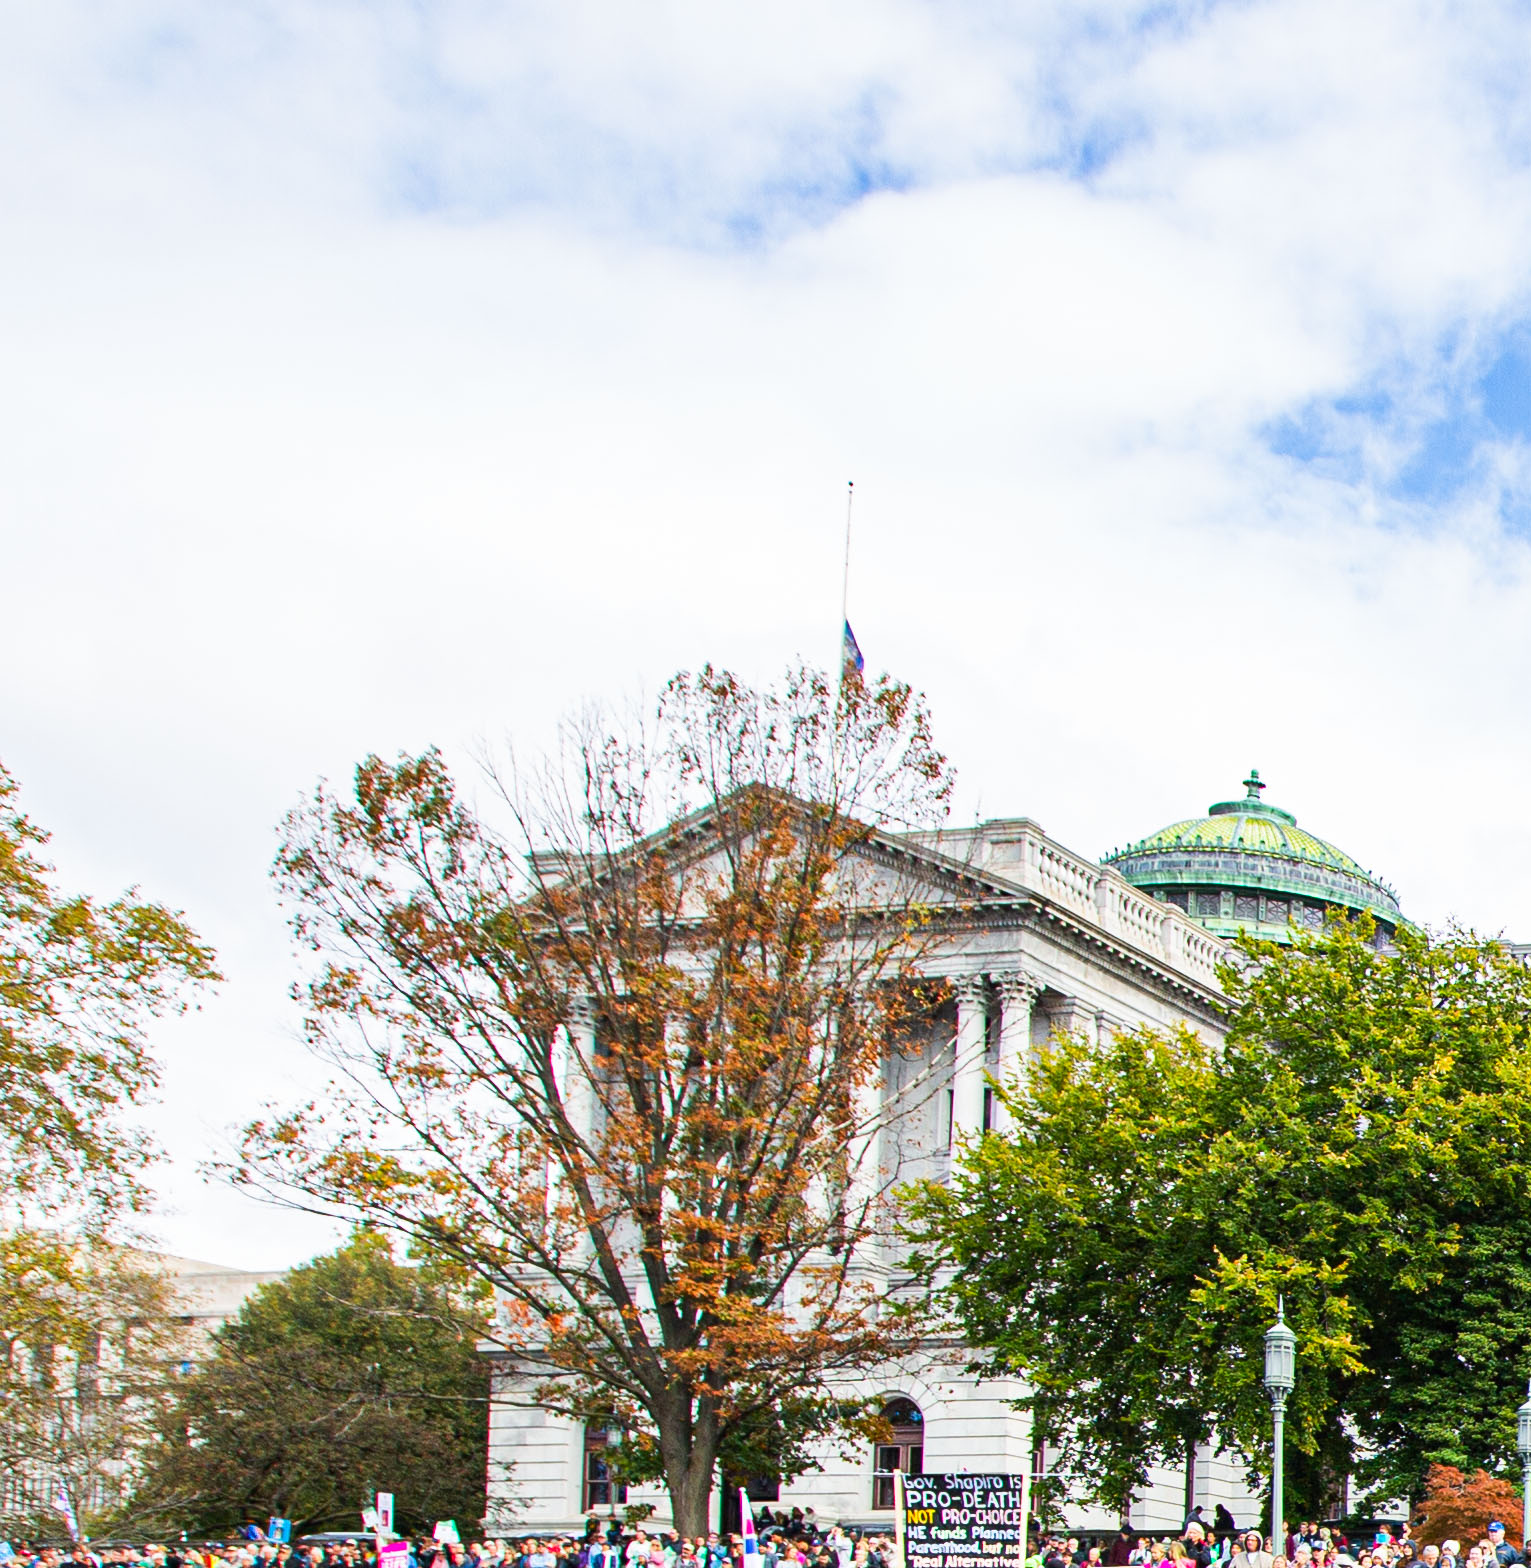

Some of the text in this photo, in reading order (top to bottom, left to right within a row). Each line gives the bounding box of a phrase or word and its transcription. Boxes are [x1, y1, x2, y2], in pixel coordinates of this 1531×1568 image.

[903, 1474, 937, 1489] Gov.
[945, 1474, 1003, 1493] Shapiro
[906, 1491, 1021, 1508] PRO-DEATH
[907, 1509, 1021, 1525] NOT PRO-CHOICE
[908, 1526, 927, 1539] HE
[930, 1526, 967, 1540] funds
[908, 1541, 981, 1555] Parenthood,
[982, 1541, 1003, 1555] but
